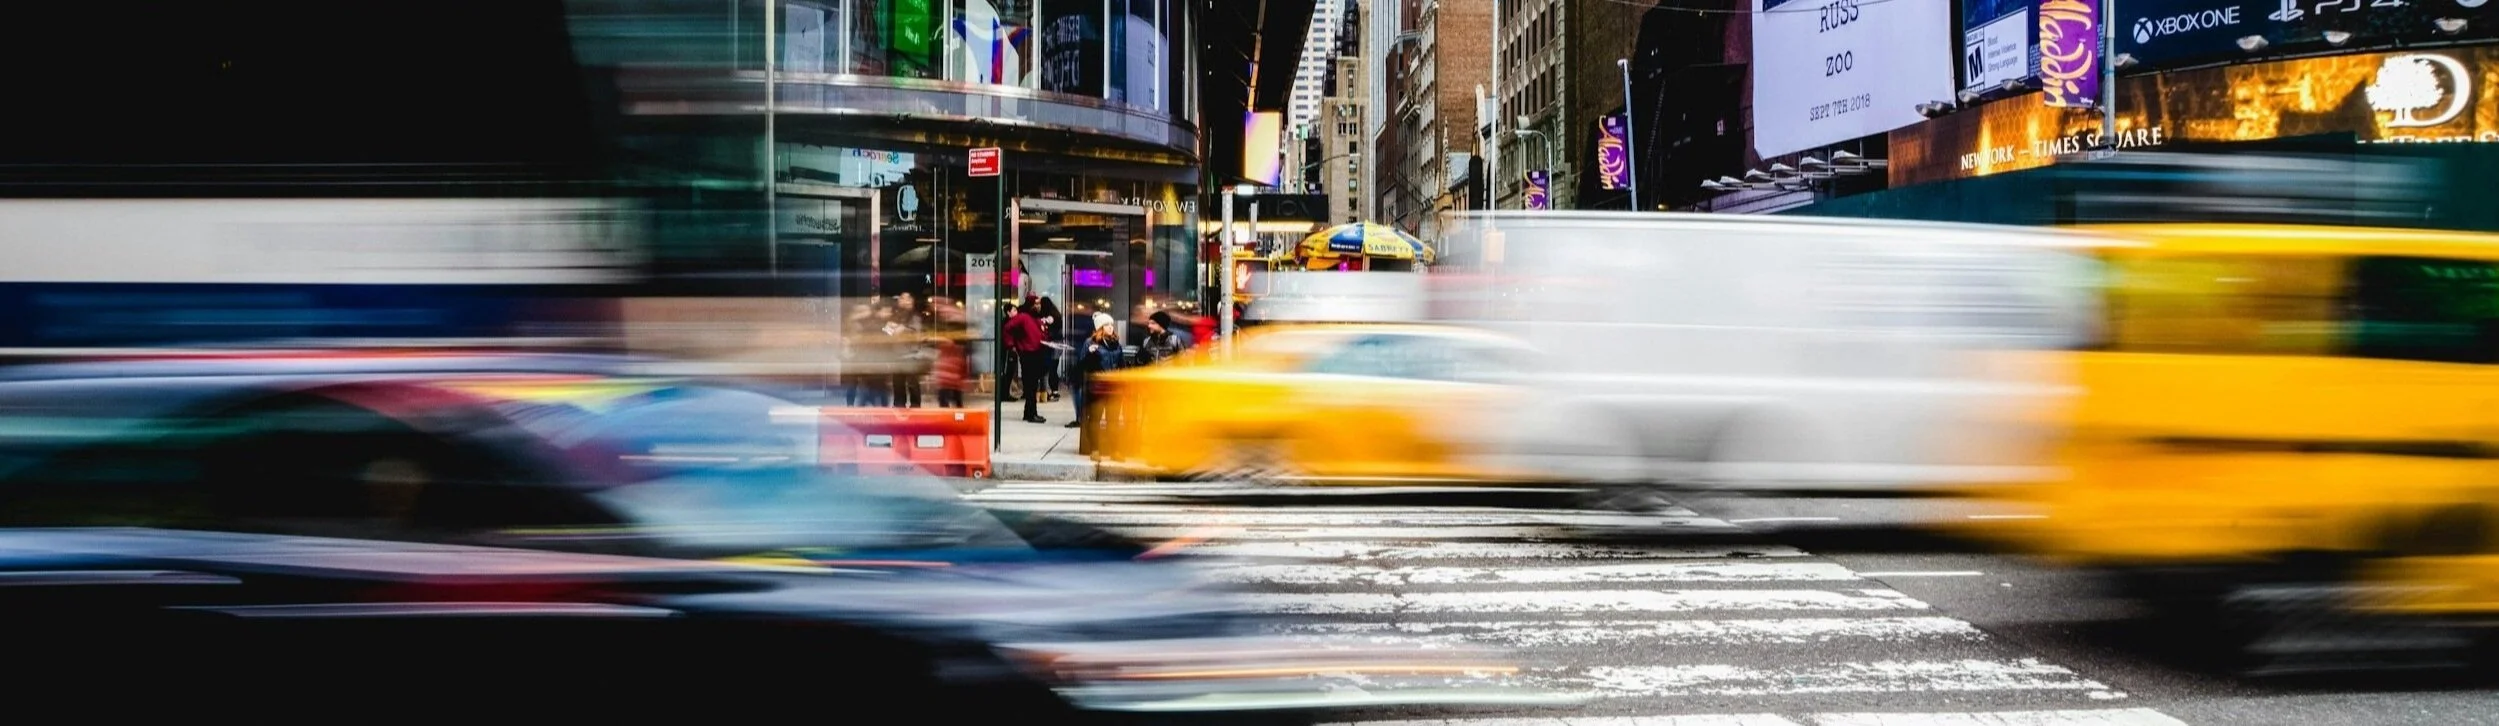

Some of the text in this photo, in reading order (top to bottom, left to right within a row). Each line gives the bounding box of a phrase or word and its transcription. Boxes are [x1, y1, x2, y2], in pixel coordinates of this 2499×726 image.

[1819, 0, 1859, 33] RUSS
[2155, 5, 2241, 37] XBOX ONE
[1826, 50, 1853, 77] ZOO
[1968, 46, 1983, 83] M
[2039, 0, 2092, 108] laddin
[1809, 93, 1871, 121] SEPT 7TH 2018
[1961, 148, 1988, 170] NEW
[2034, 135, 2080, 158] TIMES
[2086, 126, 2163, 149] SARE
